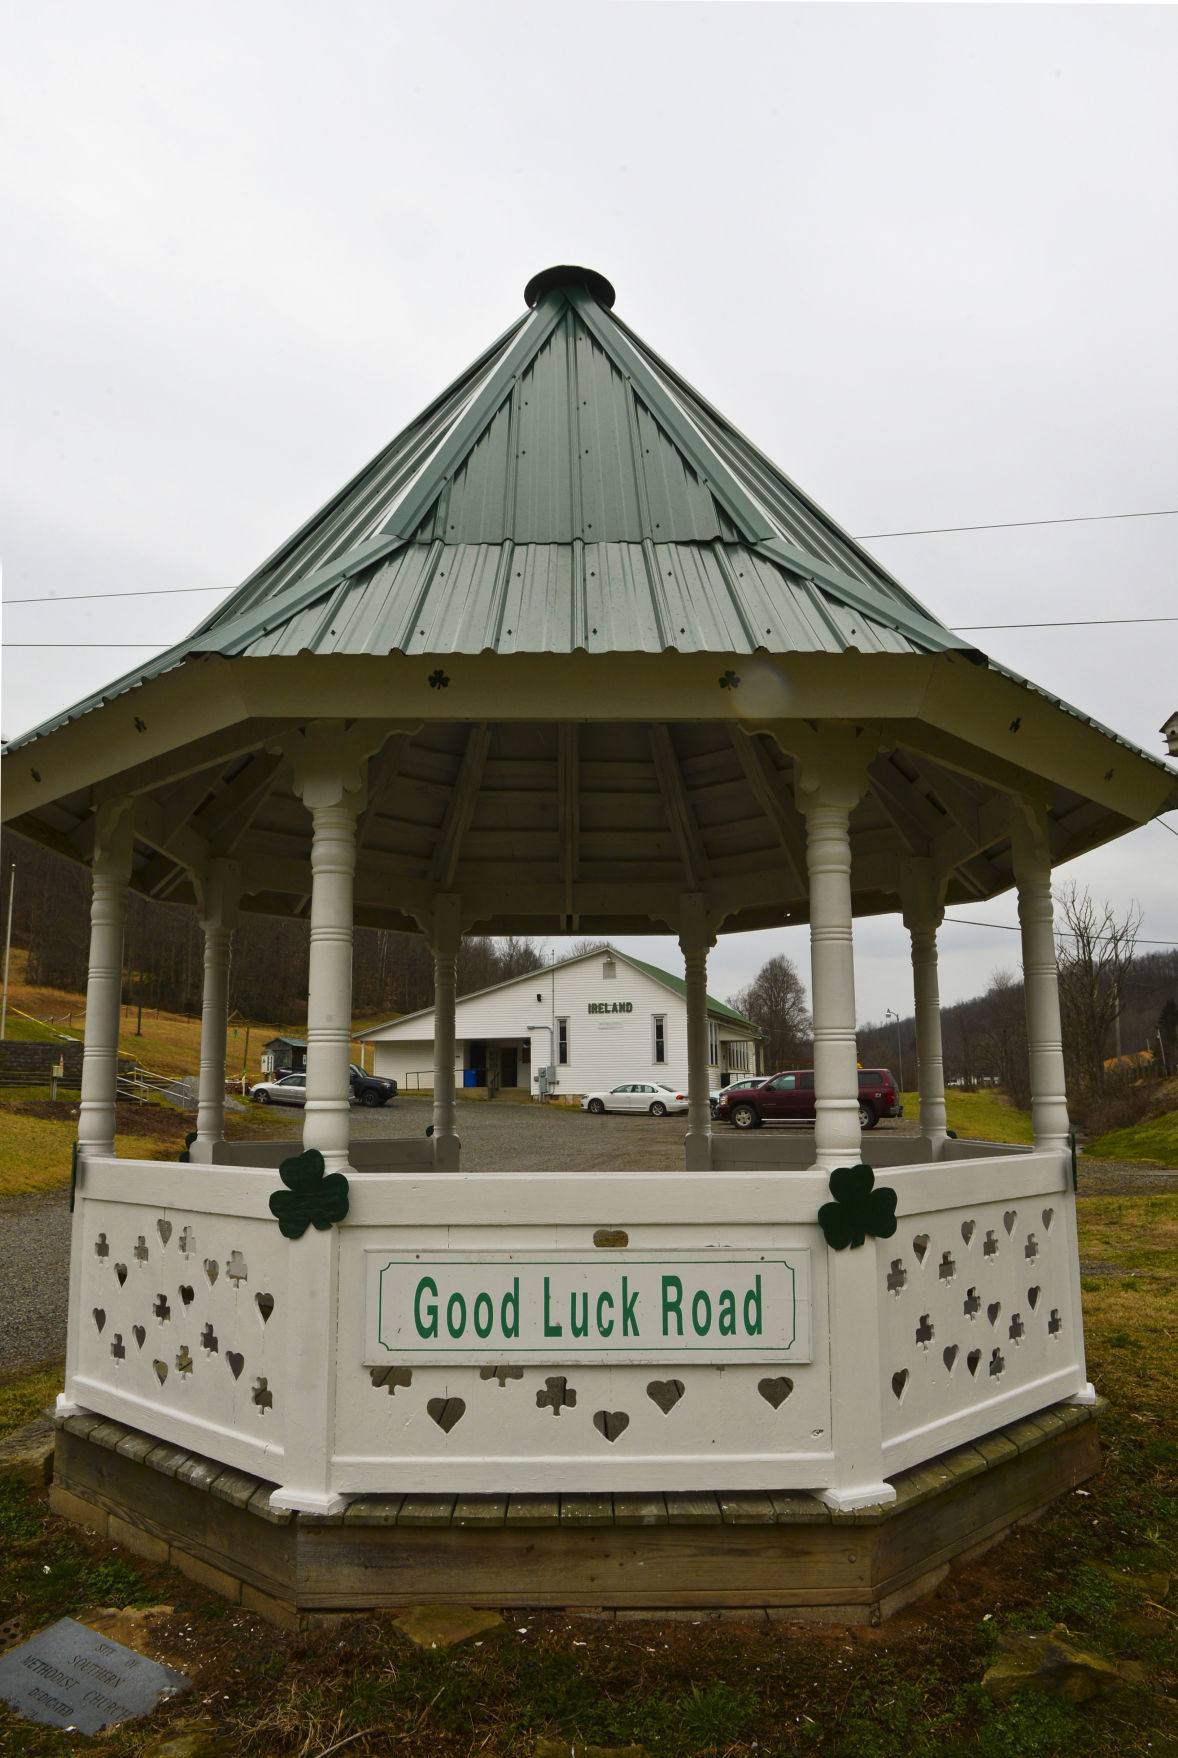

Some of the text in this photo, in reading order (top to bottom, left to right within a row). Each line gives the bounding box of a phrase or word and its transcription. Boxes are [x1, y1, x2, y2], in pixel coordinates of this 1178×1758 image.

[588, 1002, 633, 1014] IRELAND
[414, 1275, 762, 1339] Good Luck Road
[22, 1654, 135, 1720] METHODIST CHURCH
[68, 1655, 126, 1688] SOUTHERN
[27, 1687, 75, 1717] DEDICATED
